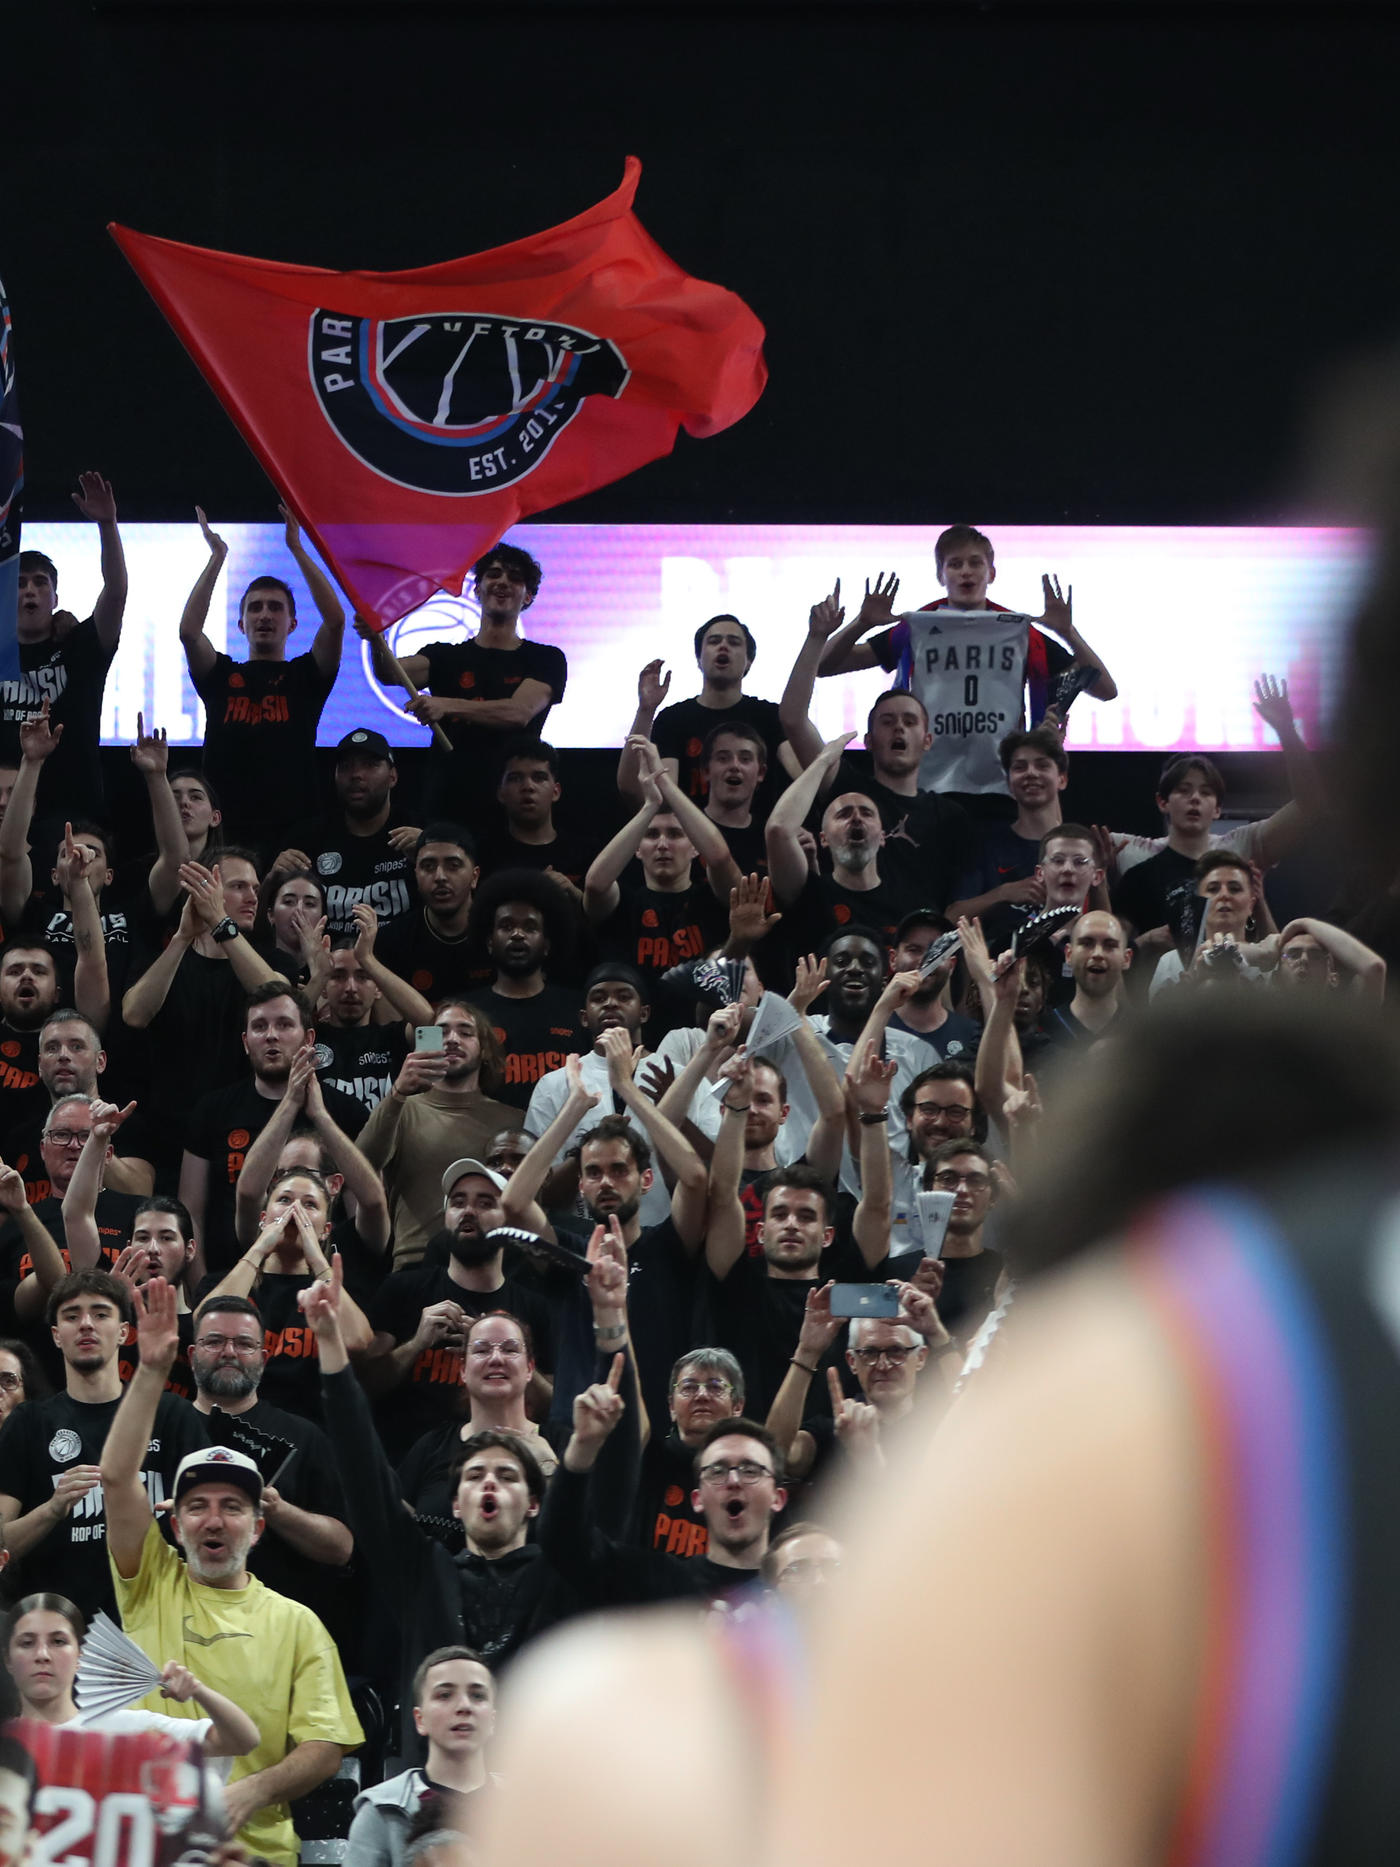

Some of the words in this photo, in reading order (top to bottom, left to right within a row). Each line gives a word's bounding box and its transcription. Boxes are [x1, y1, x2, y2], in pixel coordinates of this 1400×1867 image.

[320, 317, 356, 393] PAR
[468, 447, 517, 481] EST.
[519, 402, 566, 453] 201
[925, 644, 1015, 674] PARIS
[964, 674, 979, 707] 0
[934, 710, 1005, 739] snipes
[373, 857, 407, 874] snipes
[322, 878, 410, 920] ARISII
[71, 1526, 92, 1543] KOP
[28, 1784, 156, 1867] 20
